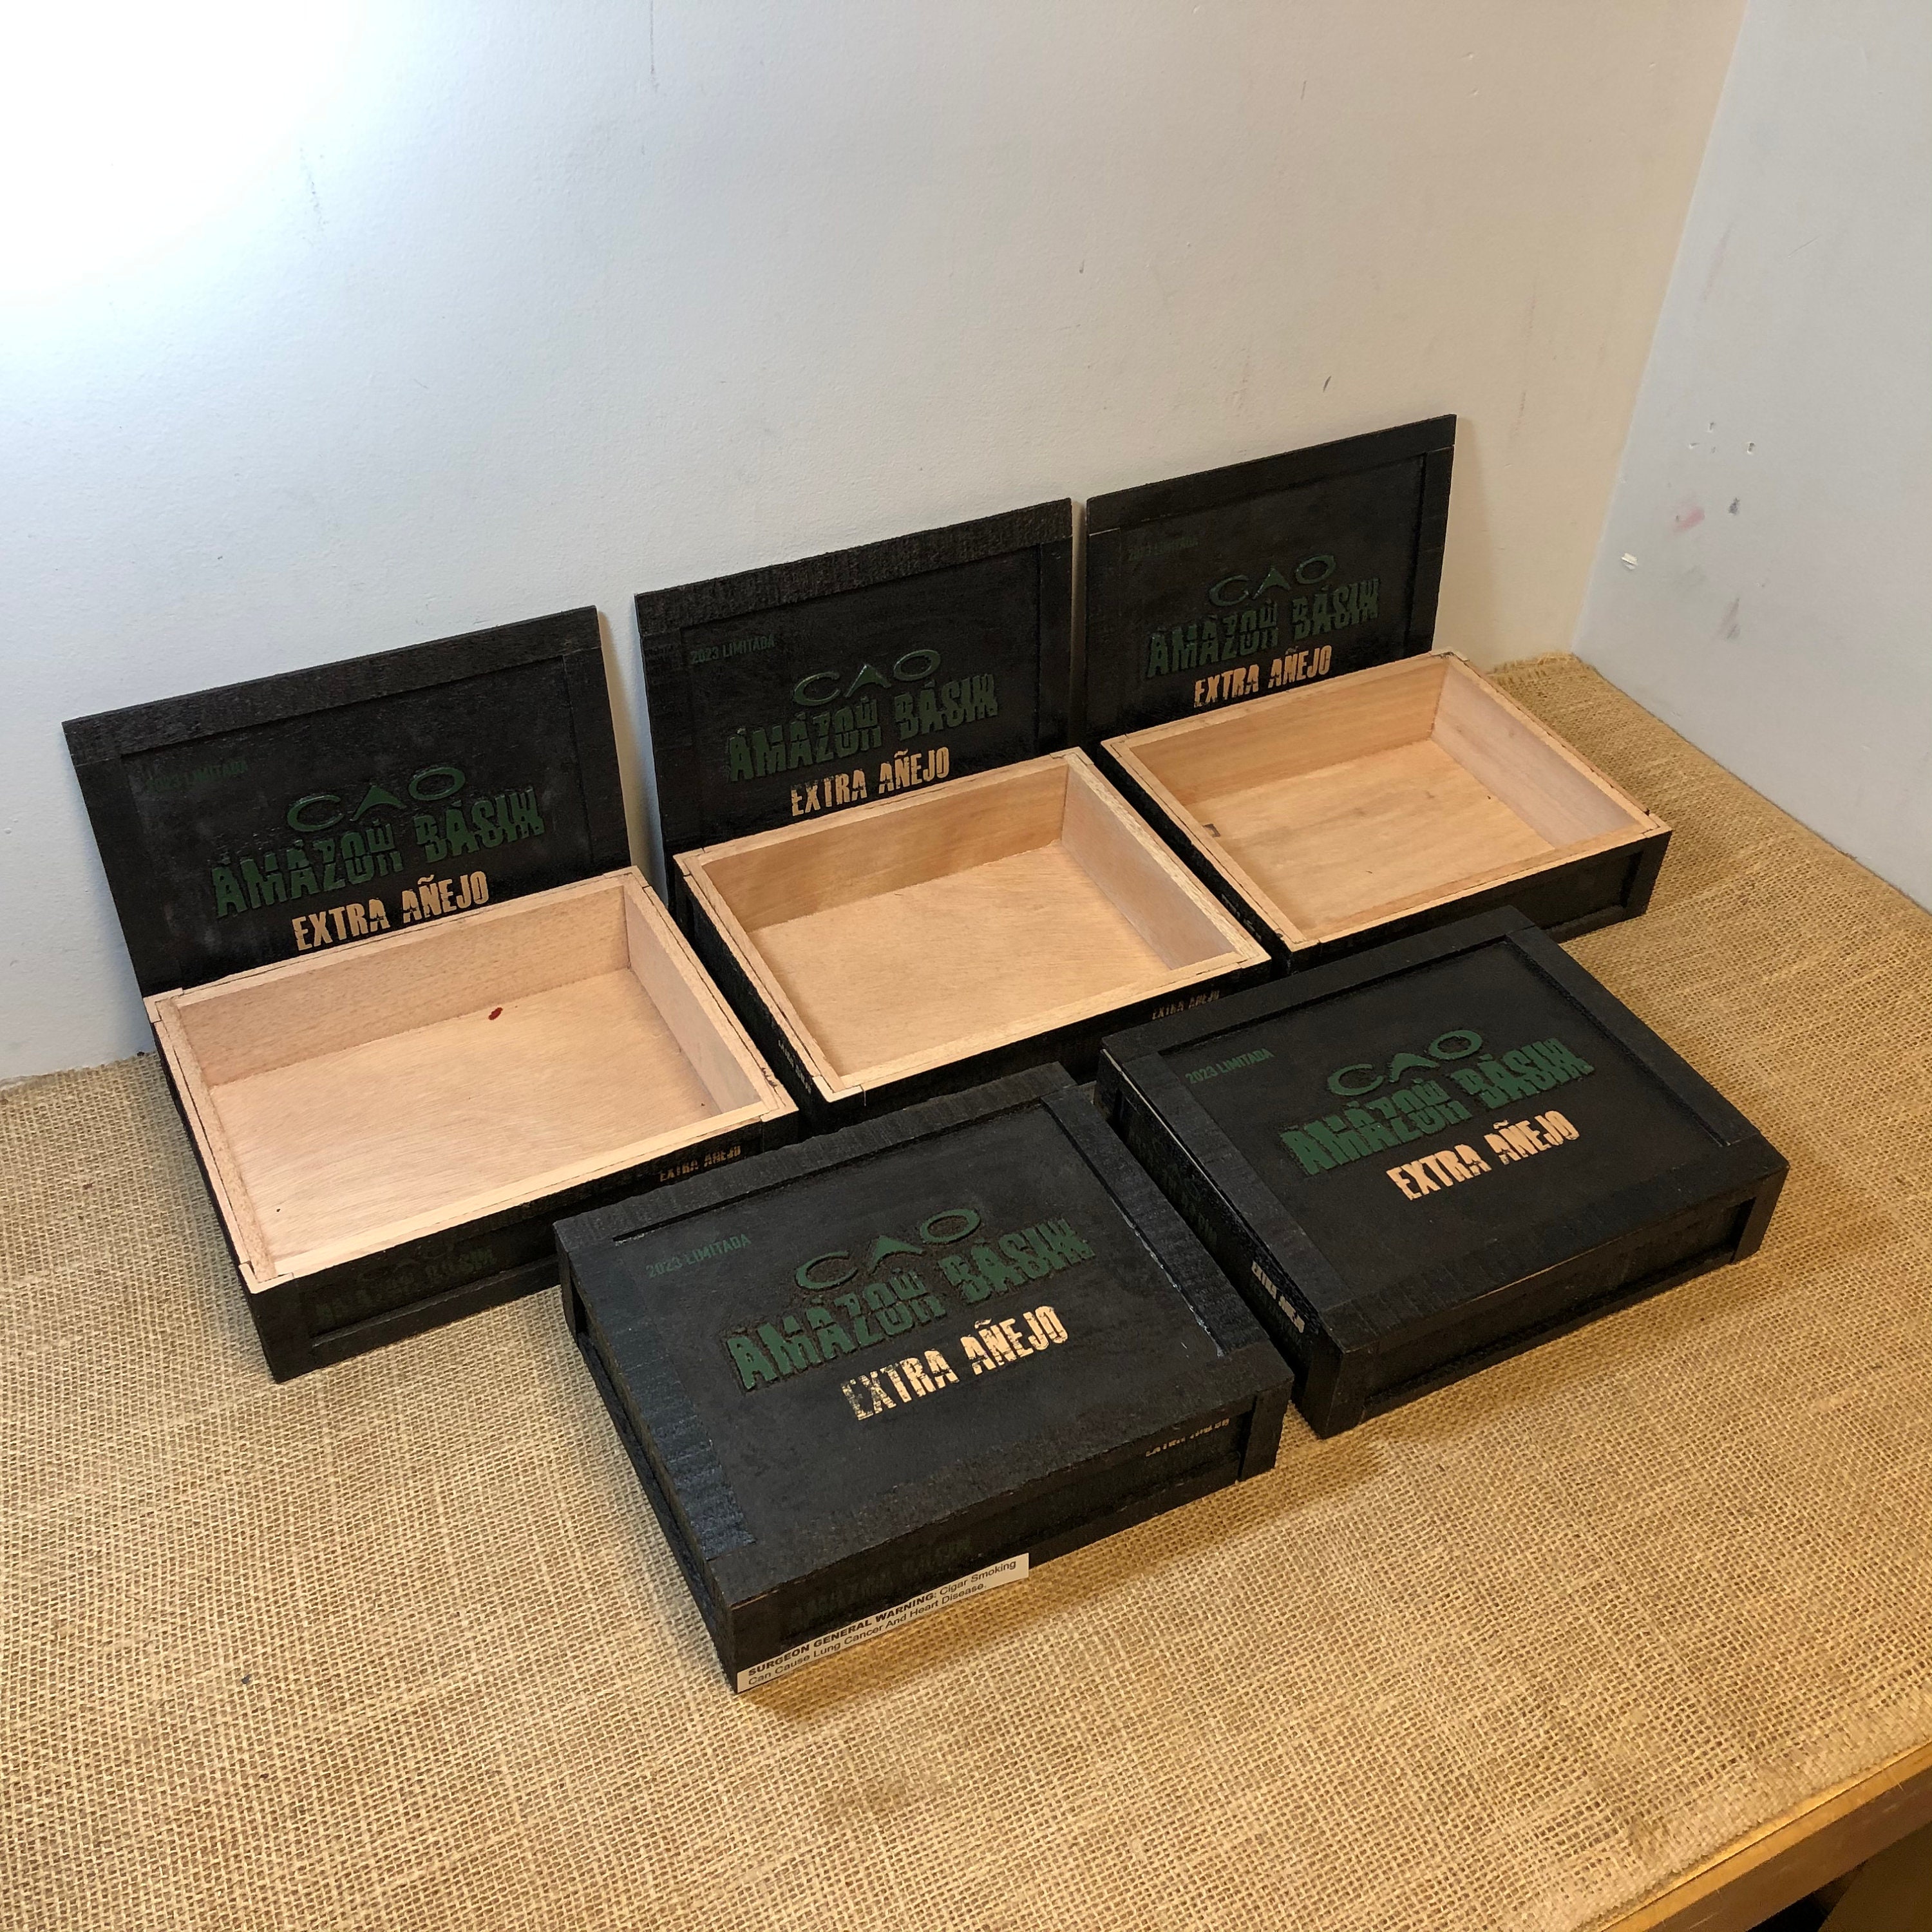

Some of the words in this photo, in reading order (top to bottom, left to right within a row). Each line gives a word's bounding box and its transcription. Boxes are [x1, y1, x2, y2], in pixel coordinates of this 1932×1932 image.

[1209, 554, 1336, 607] CAO
[793, 649, 941, 706] CAO
[1193, 663, 1260, 708] EXTRA
[1268, 645, 1333, 688] AÑEJO
[286, 767, 466, 832] CAO
[790, 768, 867, 817] EXTRA
[878, 746, 950, 794] AÑEJO
[291, 898, 391, 952] EXTRA
[401, 870, 490, 925] AÑEJO
[1185, 1065, 1218, 1084] 2023
[1215, 1048, 1275, 1074] LIMITADA
[1327, 1030, 1482, 1095] CAO
[1386, 1144, 1492, 1200] EXTRA
[1484, 1110, 1580, 1165] AÑEJO
[646, 1256, 683, 1278] 2023
[685, 1233, 752, 1265] LIMITADA
[795, 1208, 981, 1290] CAO
[841, 1349, 960, 1420] EXTRA
[960, 1305, 1069, 1375] AÑEJO
[748, 1643, 810, 1676] SURGEON
[813, 1620, 873, 1647] GENERAL
[875, 1592, 937, 1623] WARNING:
[940, 1578, 969, 1595] Cigar
[971, 1560, 1017, 1582] Smoking
[748, 1672, 772, 1685] Can
[774, 1654, 810, 1674] Cause
[813, 1642, 841, 1659] Lung
[844, 1624, 884, 1645] Cancer
[885, 1613, 907, 1629] And
[909, 1600, 939, 1618] Heart
